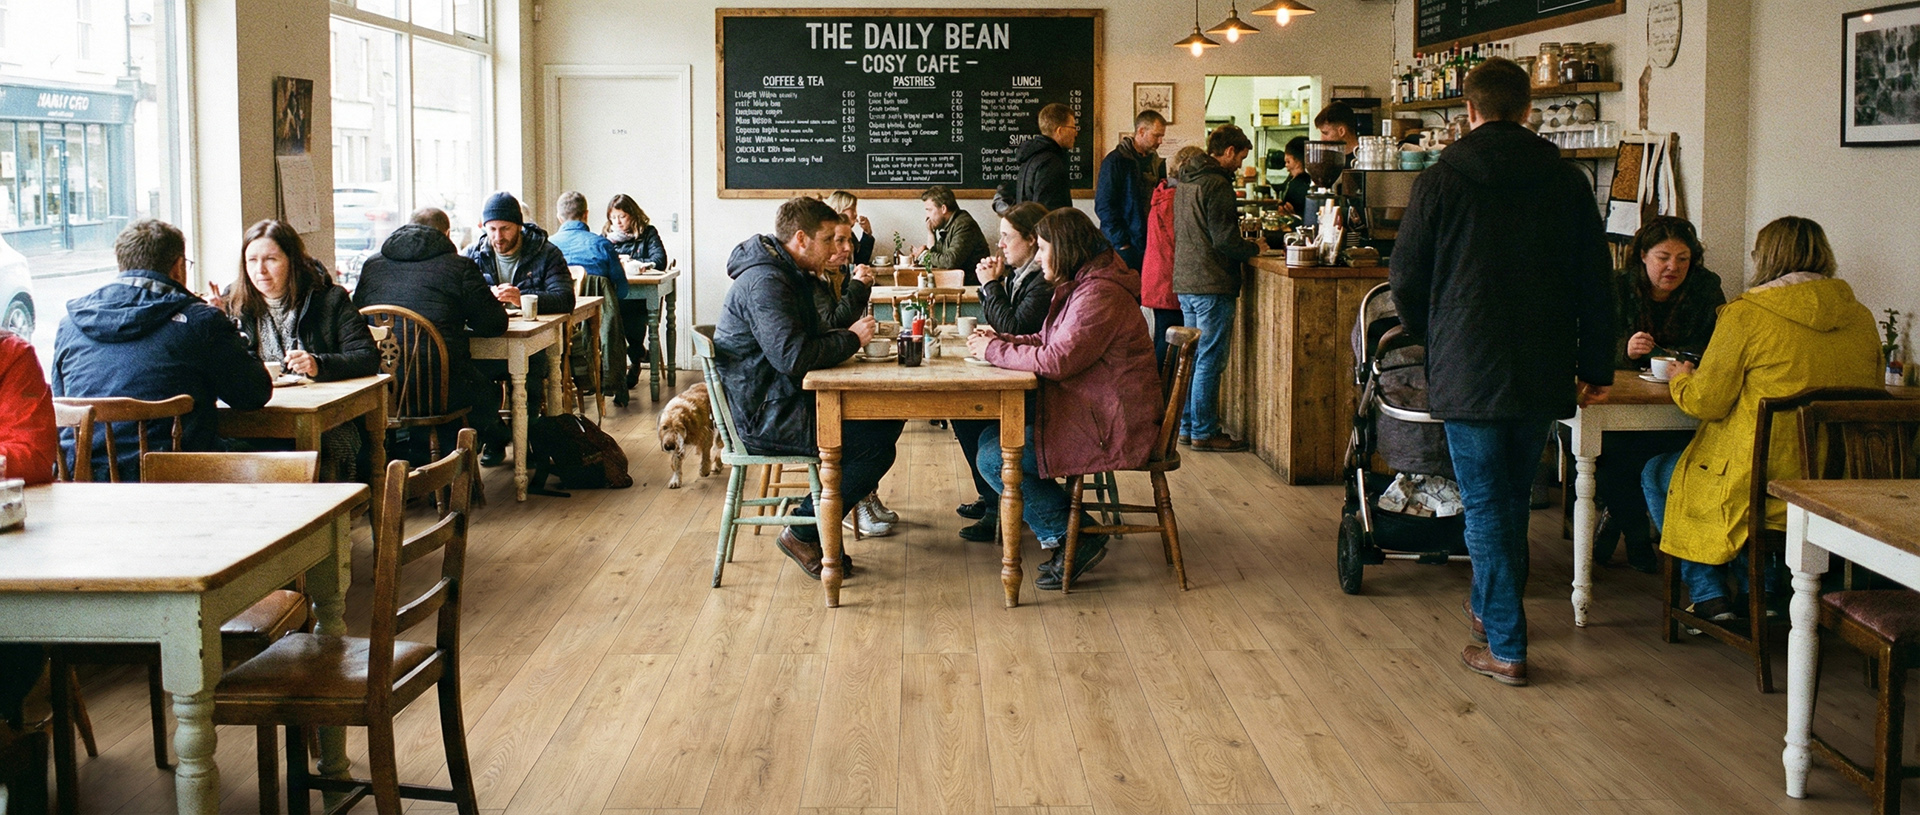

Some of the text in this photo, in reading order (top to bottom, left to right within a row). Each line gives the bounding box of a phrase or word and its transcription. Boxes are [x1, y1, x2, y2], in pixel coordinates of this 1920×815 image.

[806, 23, 1009, 49] THE DAILY BEAN
[863, 55, 959, 73] COSY CAFE
[763, 76, 824, 86] COFFEE & TEA
[894, 76, 934, 86] PASTRIES
[1013, 76, 1040, 86] LUNCH
